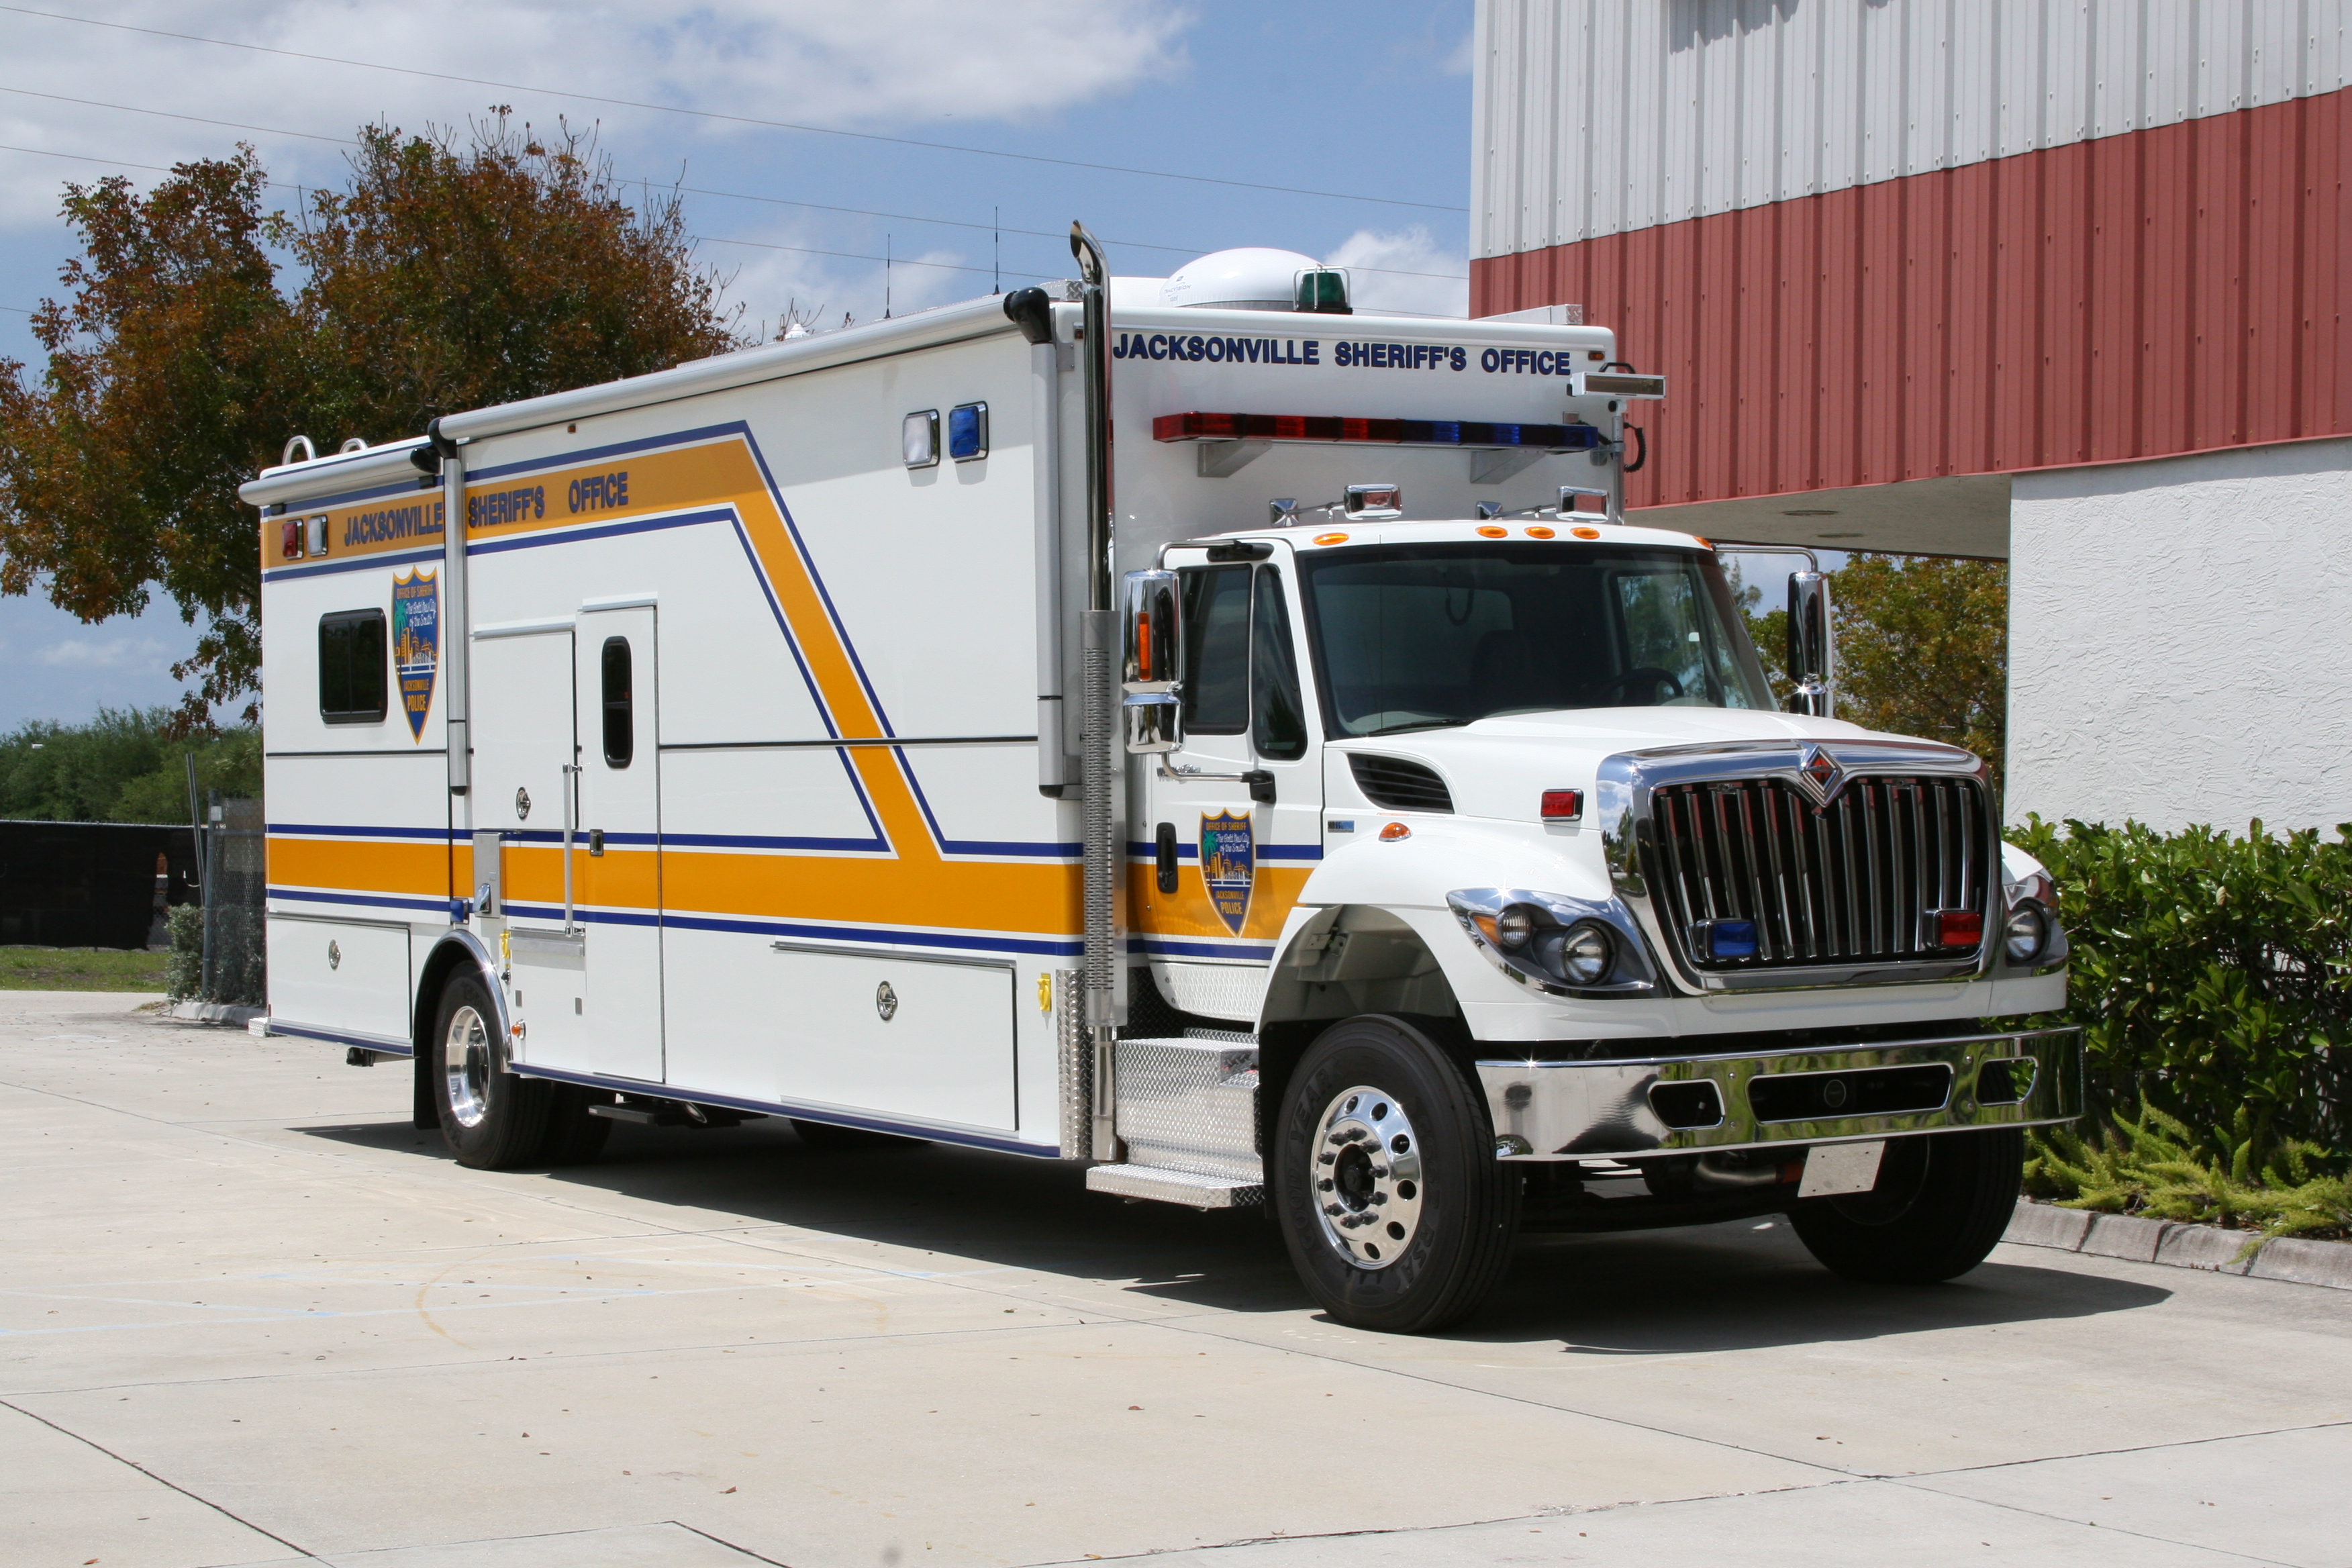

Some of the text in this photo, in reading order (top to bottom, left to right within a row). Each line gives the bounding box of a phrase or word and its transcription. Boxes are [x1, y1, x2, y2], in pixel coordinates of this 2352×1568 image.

[1113, 333, 1571, 376] JACKSONVILLE SHERIFF'S OFFICE
[344, 471, 629, 547] JACKSONVILLE SHERIFF'S OFFICE
[397, 584, 433, 599] OFFICE OF SHERIFF
[403, 679, 430, 691] JACKSONVILLE
[407, 694, 426, 712] POLICE
[1206, 822, 1246, 831] OFFICE OF SHERIFF
[1216, 891, 1244, 899] JACKSONVILLE
[1220, 901, 1243, 914] POLICE
